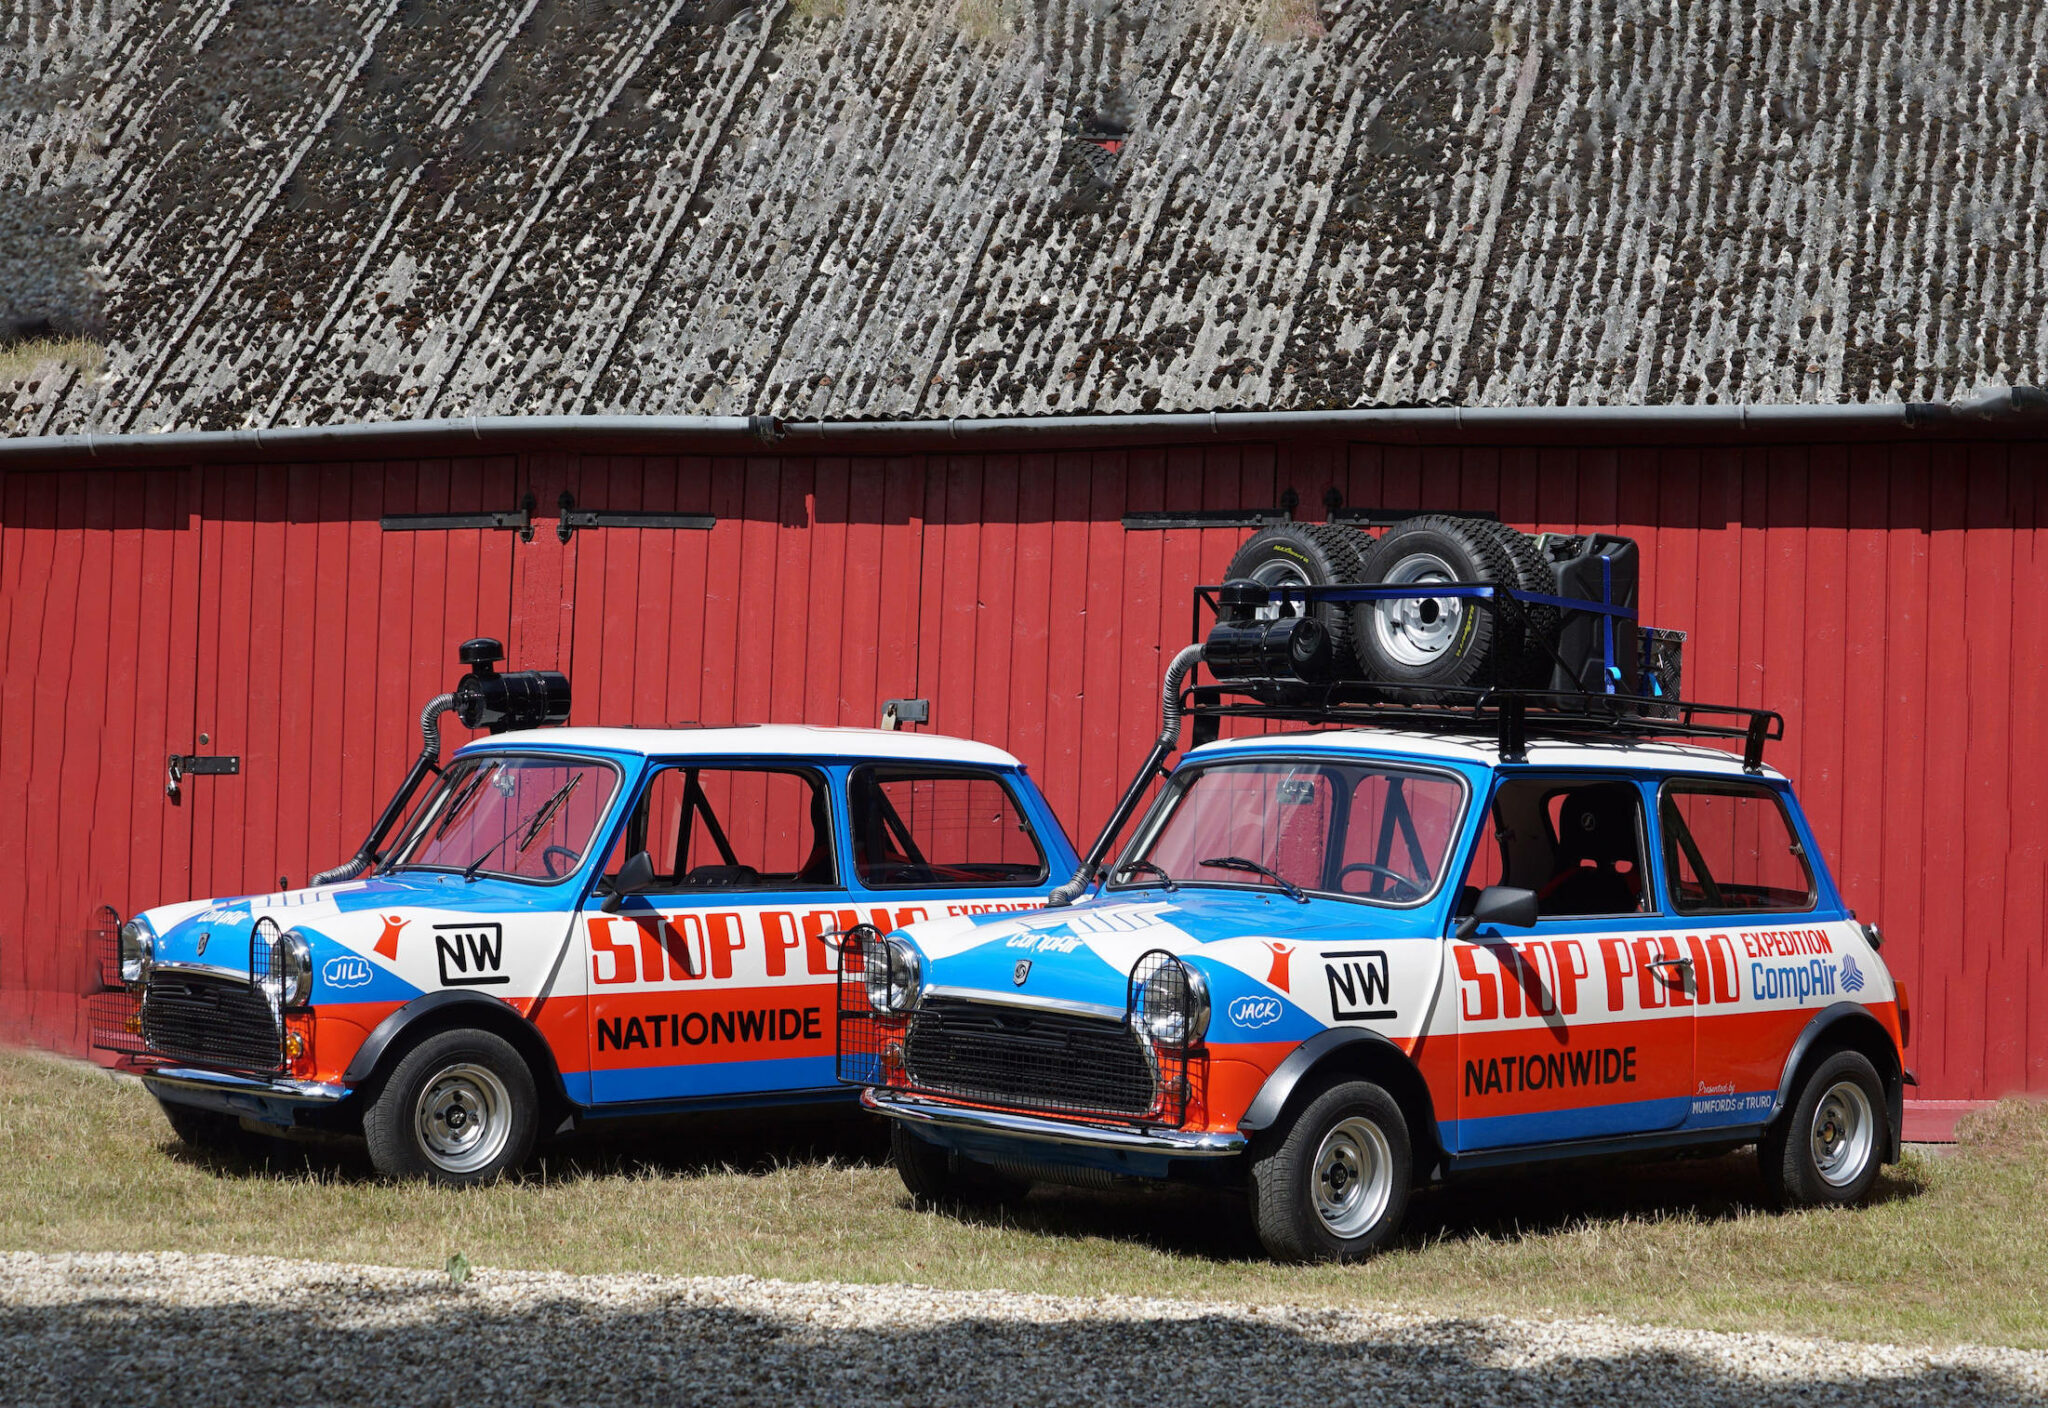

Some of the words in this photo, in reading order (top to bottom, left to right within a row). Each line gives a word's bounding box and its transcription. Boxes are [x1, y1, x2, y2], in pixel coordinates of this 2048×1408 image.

[946, 902, 1048, 917] EXPEDITI
[435, 922, 503, 986] NW
[587, 912, 745, 985] STOP
[1740, 929, 1833, 958] EXPEDITION
[328, 962, 367, 980] JILL
[1325, 950, 1389, 1021] NW
[1453, 940, 1588, 1021] STOP
[1598, 934, 1740, 1012] POLIO
[1751, 959, 1838, 1004] CompAir
[597, 1007, 822, 1051] NATIONWIDE
[1235, 1002, 1276, 1020] JACK
[1465, 1046, 1636, 1097] NATIONWIDE
[1696, 1081, 1728, 1095] Presented
[1729, 1081, 1736, 1096] by
[1692, 1099, 1737, 1114] MUMFORDS
[1737, 1100, 1744, 1110] of
[1746, 1096, 1771, 1109] TRURO
